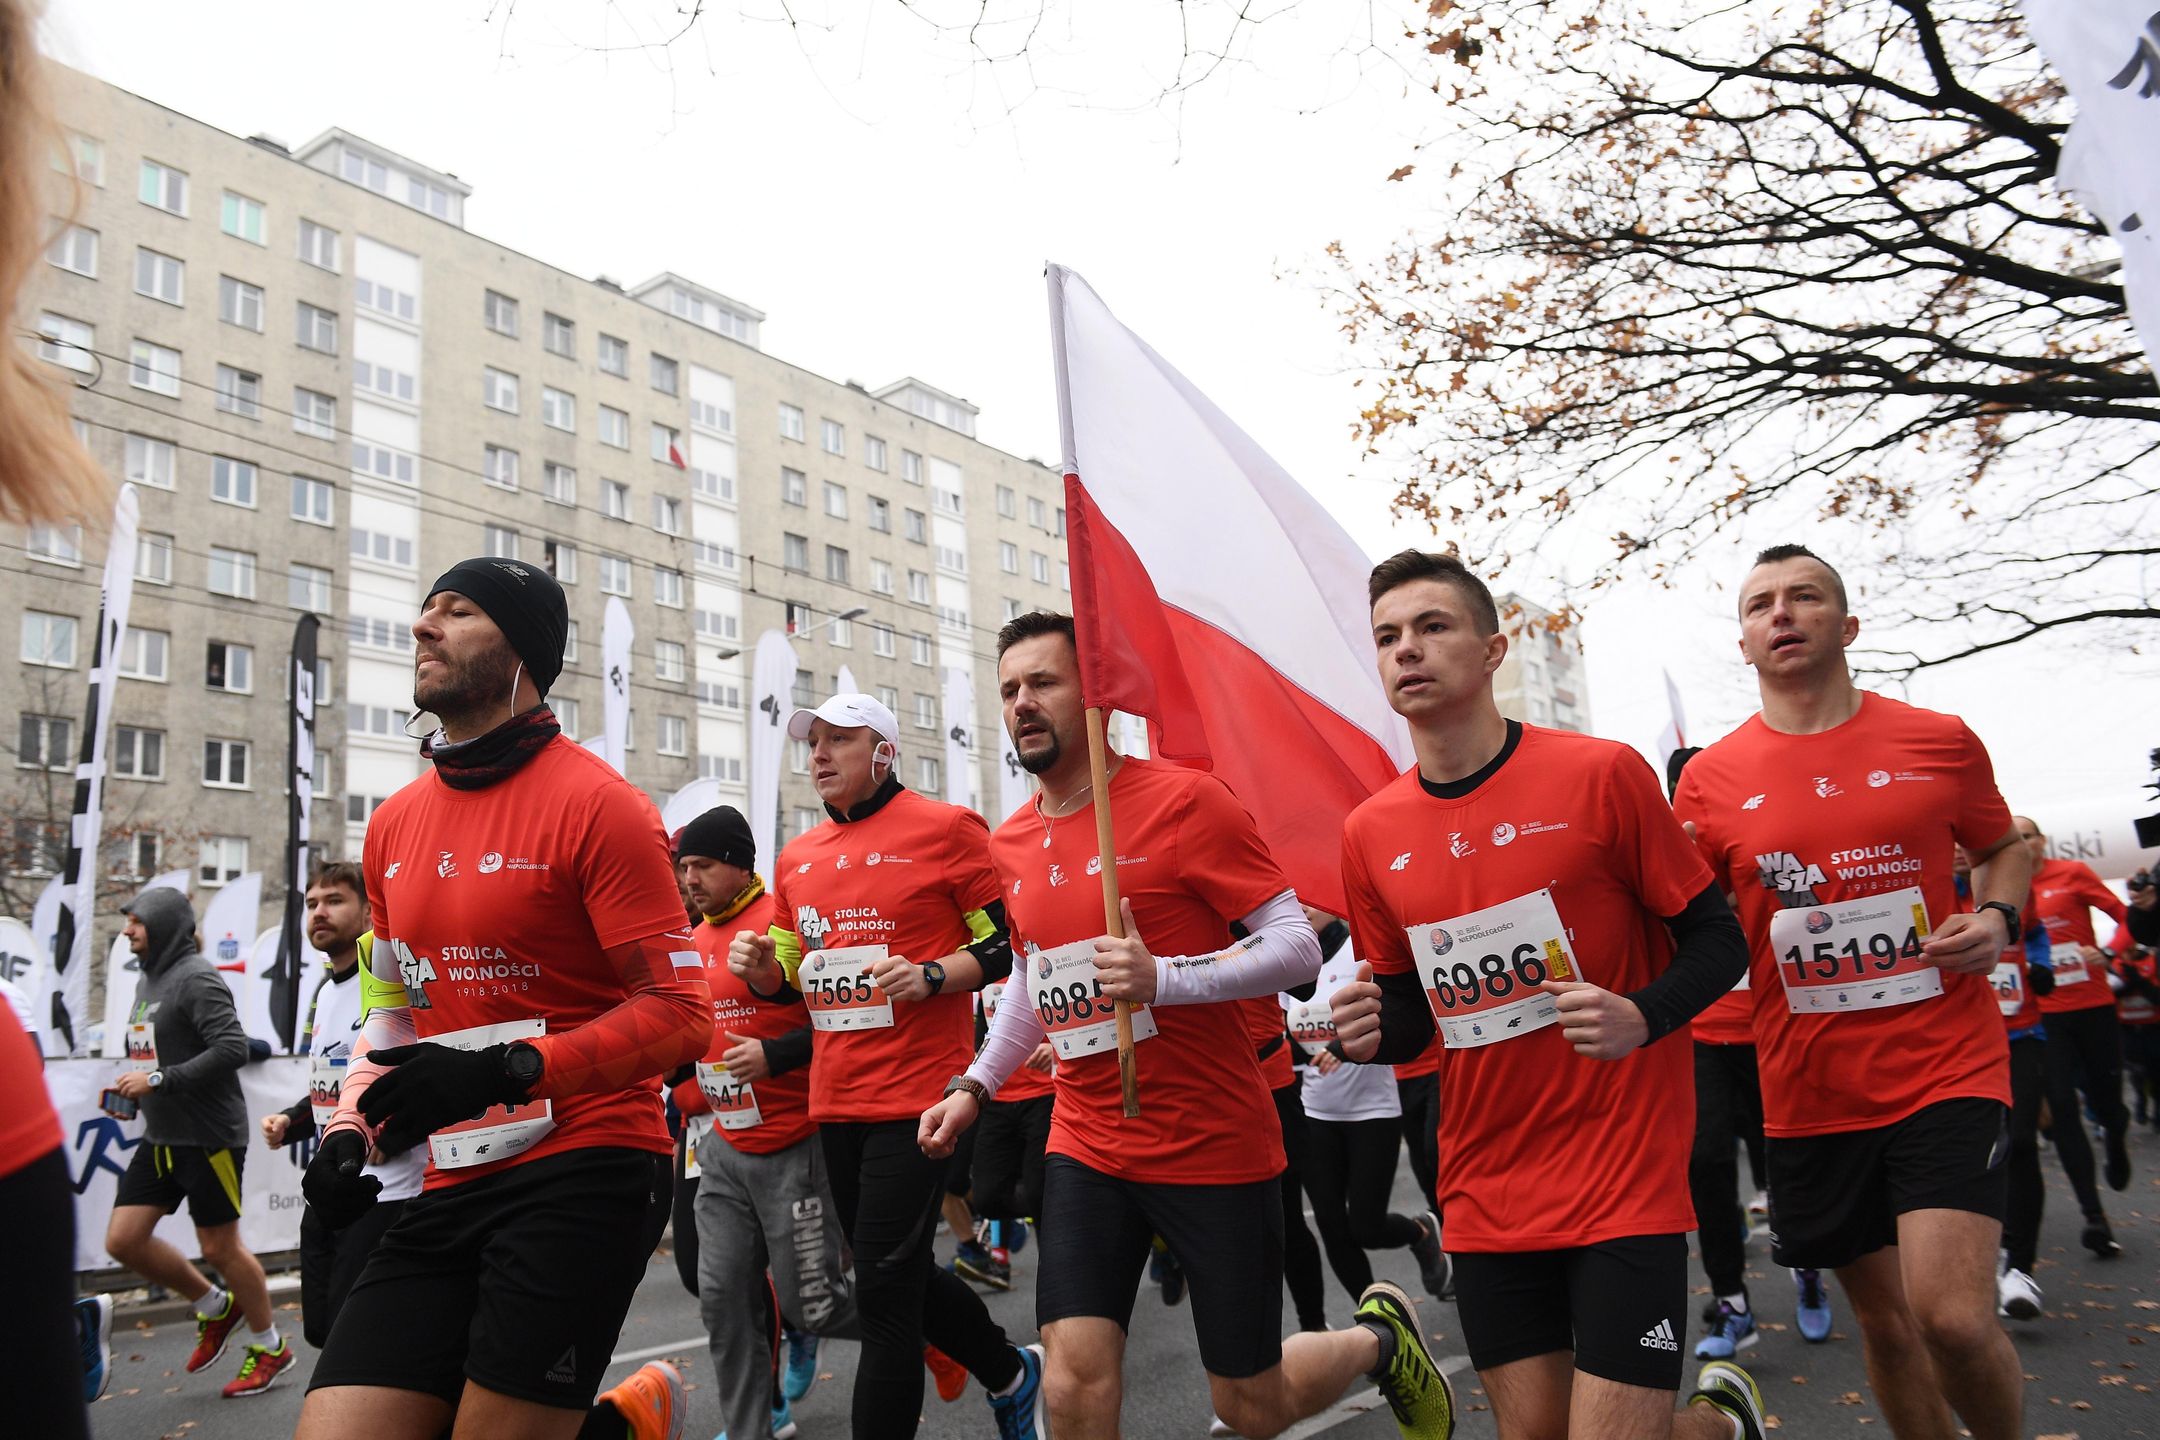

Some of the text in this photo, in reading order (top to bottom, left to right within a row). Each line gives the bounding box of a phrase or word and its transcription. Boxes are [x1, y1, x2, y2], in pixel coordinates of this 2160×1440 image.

[1742, 793, 1766, 810] 4F
[2043, 830, 2104, 860] lski
[1390, 852, 1412, 871] 4F
[1831, 843, 1904, 865] STOLICA
[1836, 857, 1922, 881] WOLNOŚCI
[1846, 877, 1914, 893] 1918-2018
[835, 907, 878, 920] STOLICA
[837, 918, 896, 932] WOLNOŚCI
[1458, 922, 1515, 944] NIEPODLEGŁOŚCI
[1466, 925, 1481, 934] BIEG
[840, 933, 885, 941] 1918-2018
[441, 946, 508, 962] STOLICA
[1785, 926, 1923, 980] 15194
[1056, 957, 1093, 970] NIEPODLEGŁOŚC
[448, 962, 541, 982] WOLNOŚCI
[1432, 943, 1546, 1009] 6986
[808, 975, 872, 1005] 7565
[714, 1006, 757, 1020] OLNOŚCI
[1296, 1021, 1338, 1039] 2259
[1507, 1016, 1522, 1028] 4F
[1087, 1037, 1098, 1046] 4F
[475, 1143, 491, 1155] 4F
[1640, 1336, 1678, 1352] adidas
